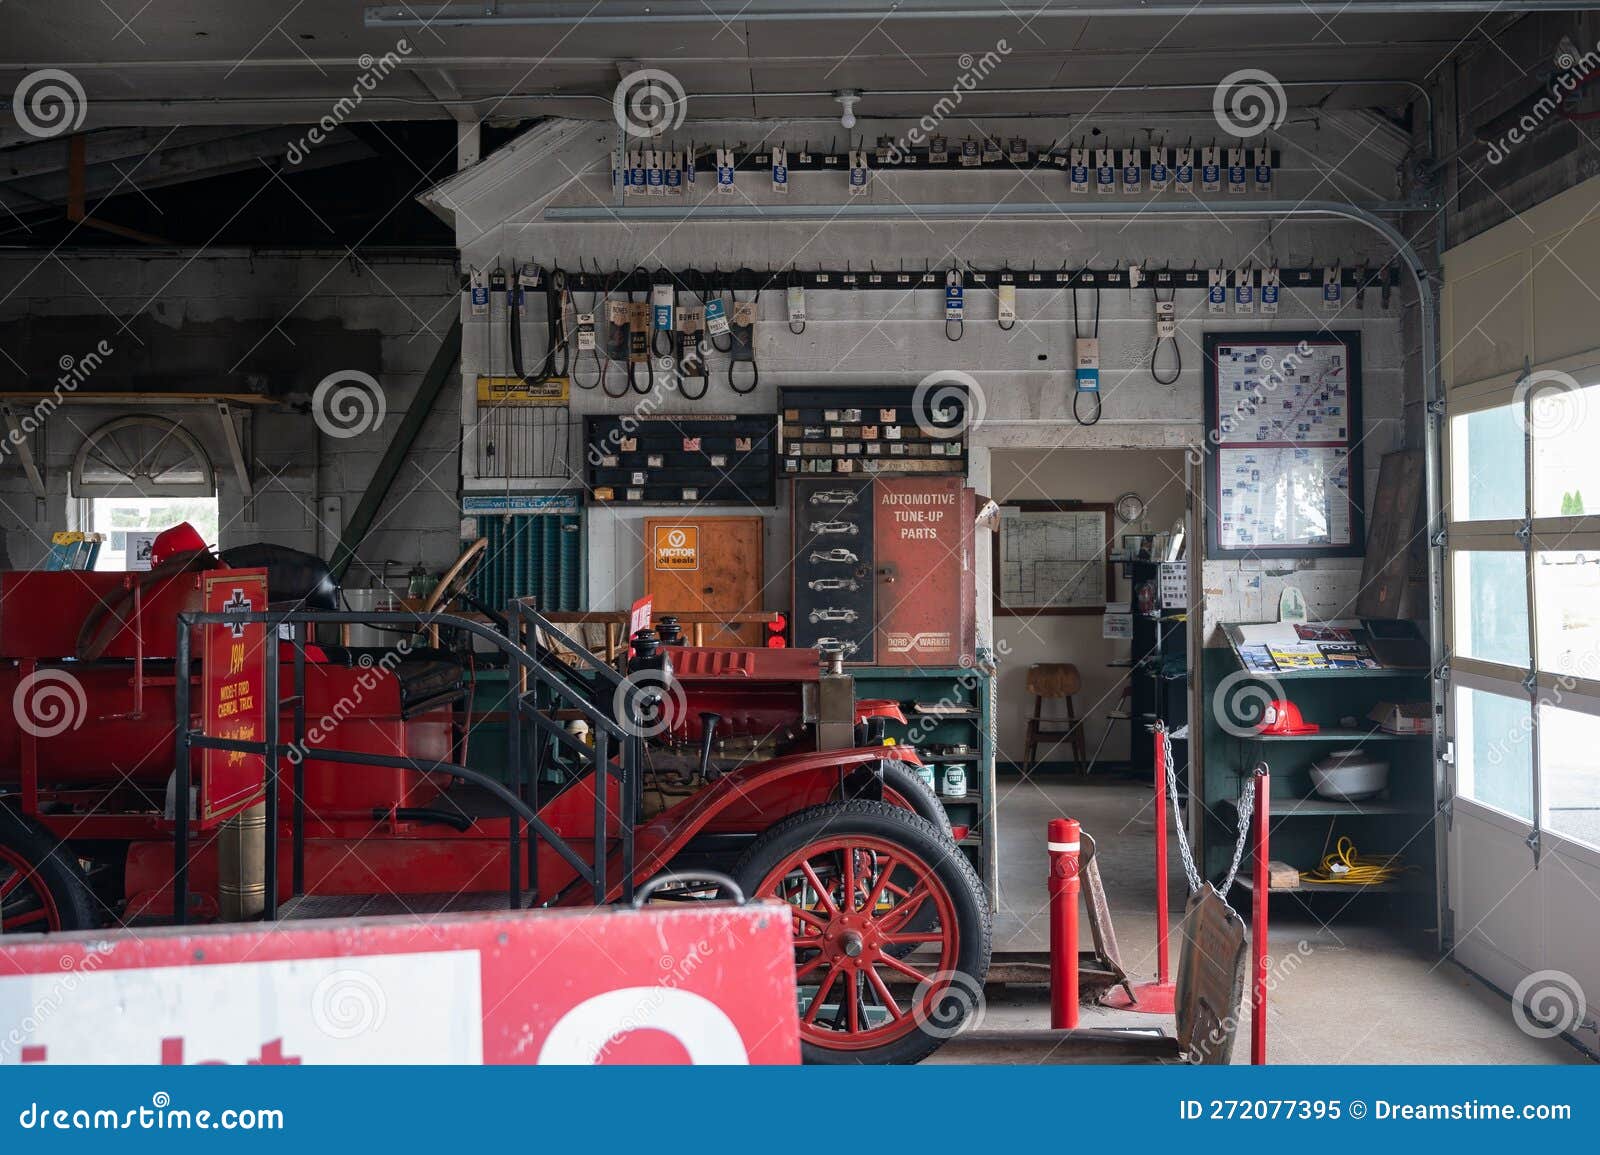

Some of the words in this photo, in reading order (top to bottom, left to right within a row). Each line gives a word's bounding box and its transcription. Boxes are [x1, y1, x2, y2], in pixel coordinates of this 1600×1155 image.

[882, 493, 955, 505] AUTOMOTIVE
[894, 511, 944, 522] TUNE-UP
[901, 528, 937, 539] PARTS
[659, 548, 695, 557] VICTOR
